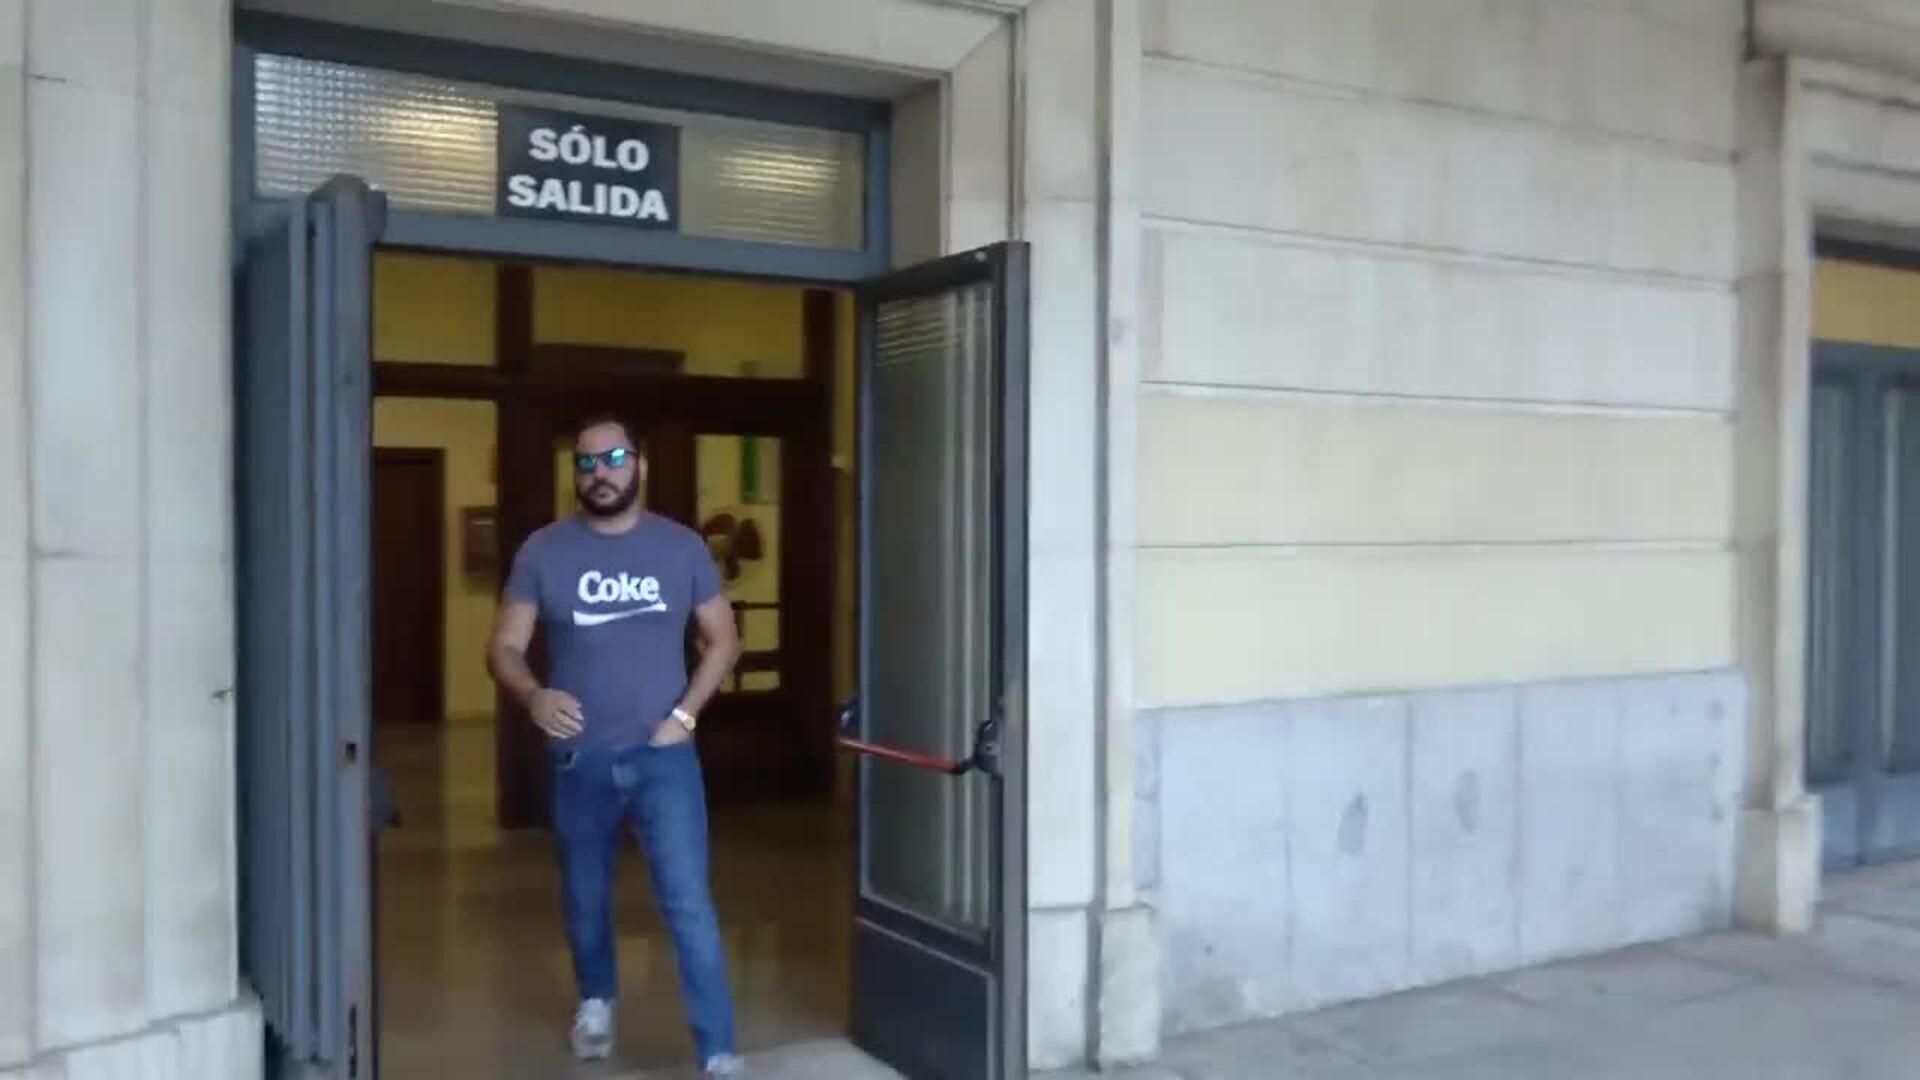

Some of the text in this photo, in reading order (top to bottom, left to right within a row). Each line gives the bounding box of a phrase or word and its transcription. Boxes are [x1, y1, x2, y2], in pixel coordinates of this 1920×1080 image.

[528, 125, 649, 171] SÓLO
[507, 174, 669, 221] SALIDA
[577, 570, 660, 604] Coke
